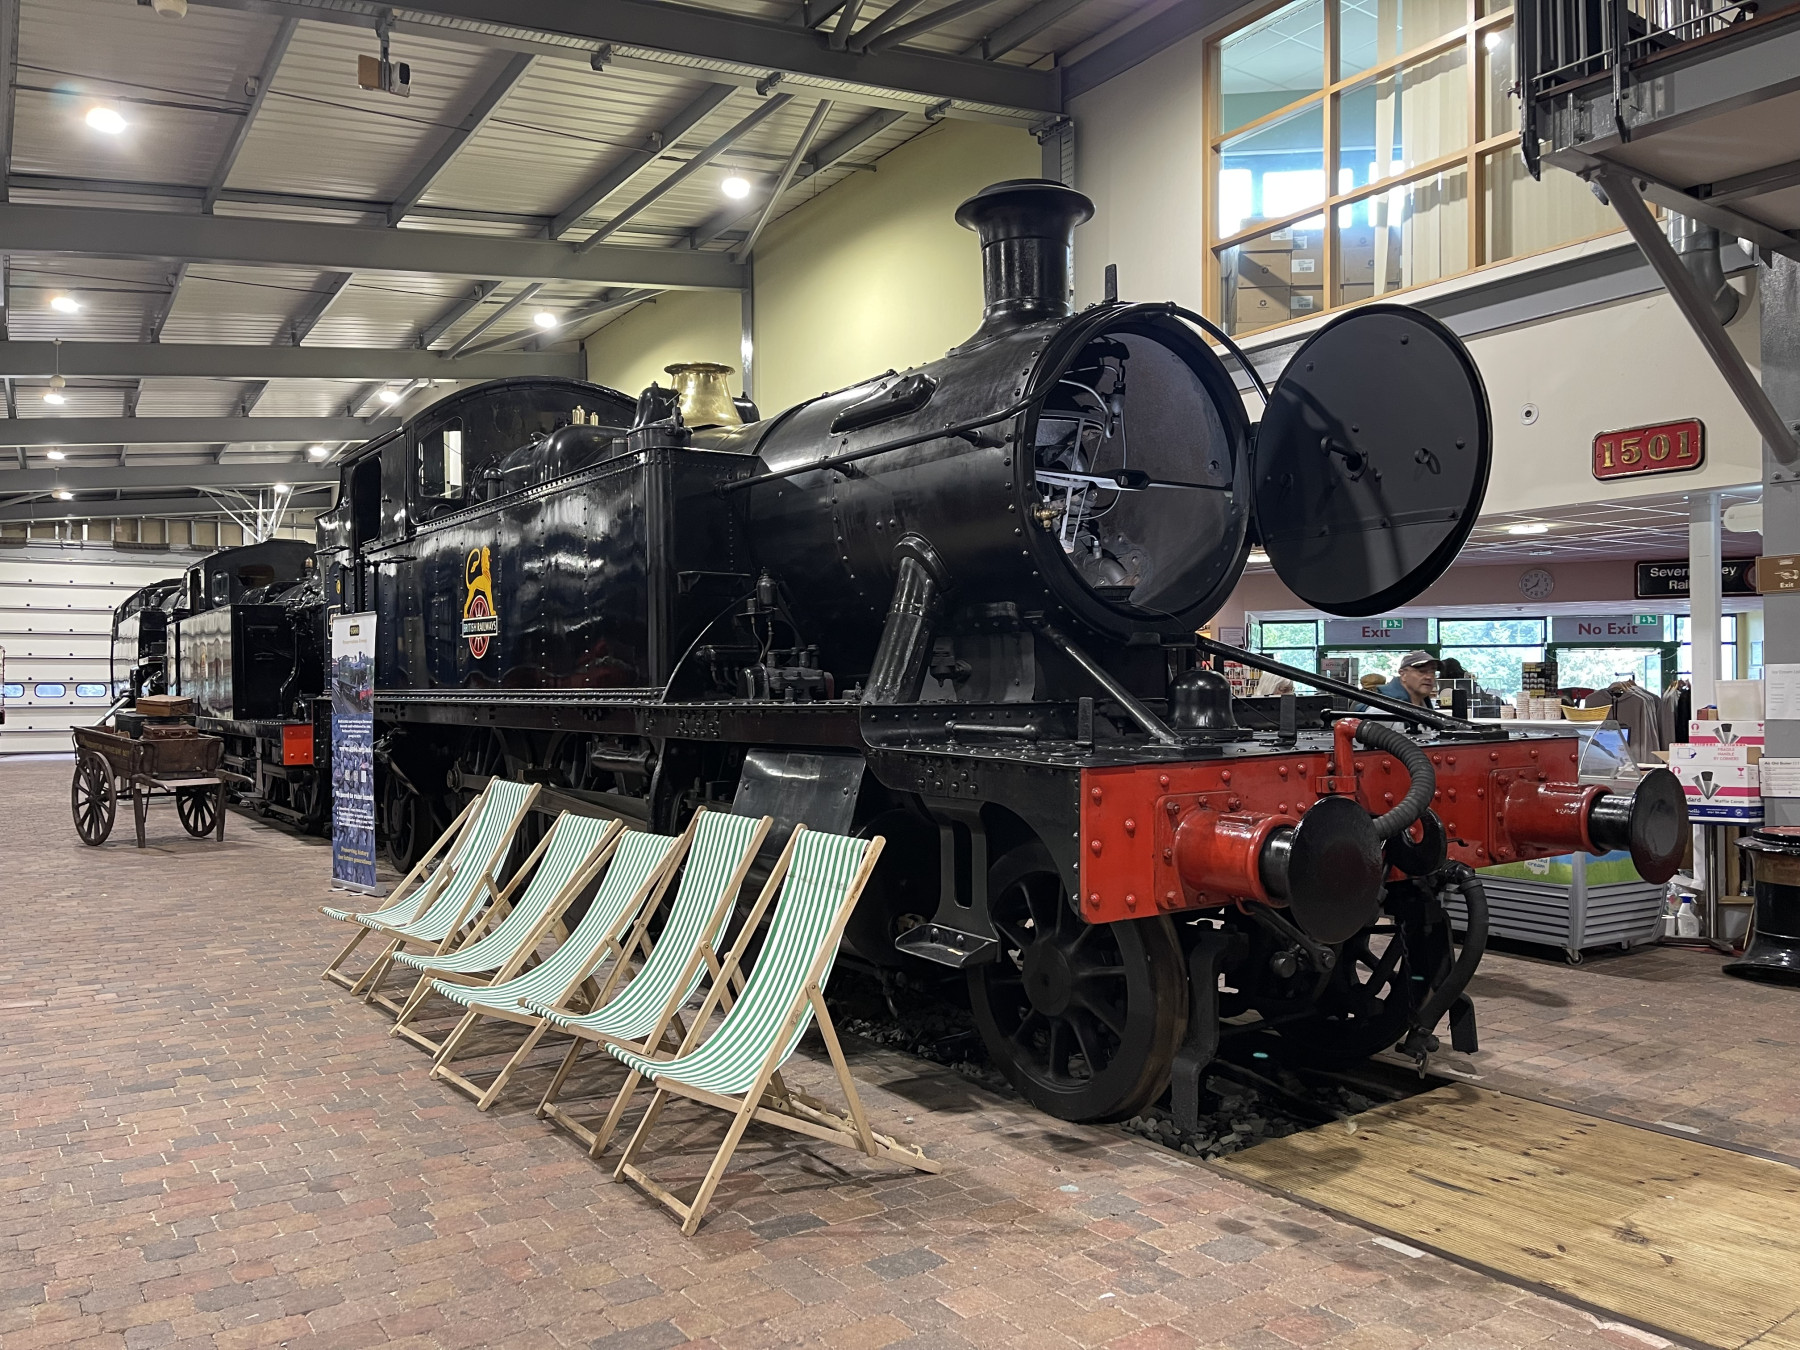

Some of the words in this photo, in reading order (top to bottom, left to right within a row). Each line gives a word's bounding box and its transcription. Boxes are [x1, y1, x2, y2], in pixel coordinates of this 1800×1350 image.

[1602, 431, 1692, 468] 1501
[463, 623, 478, 633] BRITISH
[478, 621, 496, 632] RAILWAYS
[1361, 626, 1391, 638] Exit
[1578, 623, 1602, 635] No
[1607, 622, 1639, 635] Exit
